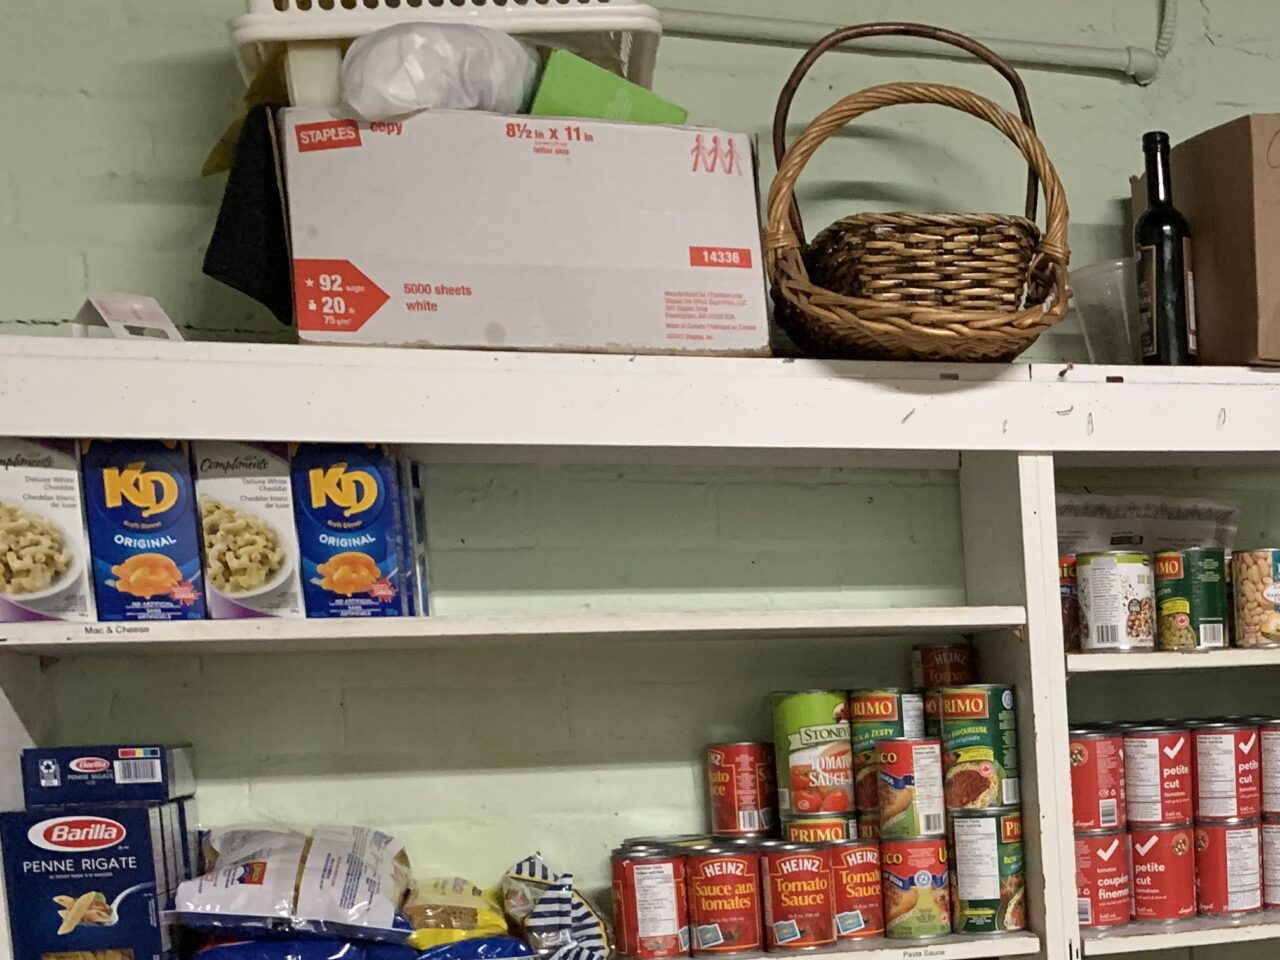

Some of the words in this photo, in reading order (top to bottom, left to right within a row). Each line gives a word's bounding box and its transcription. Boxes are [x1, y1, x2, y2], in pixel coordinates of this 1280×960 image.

[300, 126, 356, 145] STAPLES
[565, 126, 581, 142] 11
[702, 250, 741, 264] 14336
[319, 274, 343, 291] 92
[404, 283, 432, 295] 5000
[434, 284, 472, 296] sheets
[322, 297, 346, 314] 20
[406, 300, 438, 312] white
[0, 453, 54, 471] mpliments
[200, 456, 269, 473] Compliments
[103, 461, 179, 518] KD
[308, 462, 378, 517] KD
[114, 534, 177, 549] ORIGINAL
[319, 533, 376, 548] ORIGINAL
[84, 627, 104, 635] Mac
[106, 626, 113, 634] &
[115, 626, 150, 634] Cheese
[933, 652, 968, 665] HEINZ
[854, 697, 892, 719] RIMO
[944, 697, 983, 713] RIMO
[78, 758, 107, 770] Barilla
[1163, 765, 1189, 778] petite
[1164, 779, 1180, 789] cut
[1239, 774, 1253, 784] cut
[51, 822, 118, 843] Barilla
[790, 827, 842, 842] PRIMO
[23, 858, 75, 874] PENNE
[82, 856, 137, 871] RIGATE
[704, 861, 744, 878] HEINZ
[779, 857, 822, 874] HEINZ
[1135, 862, 1165, 874] petite
[775, 877, 828, 893] Tomato
[839, 869, 881, 885] Tomat
[1136, 876, 1151, 886] cut
[695, 881, 732, 897] Sauce
[701, 897, 751, 911] tomates
[781, 892, 825, 906] Sauce
